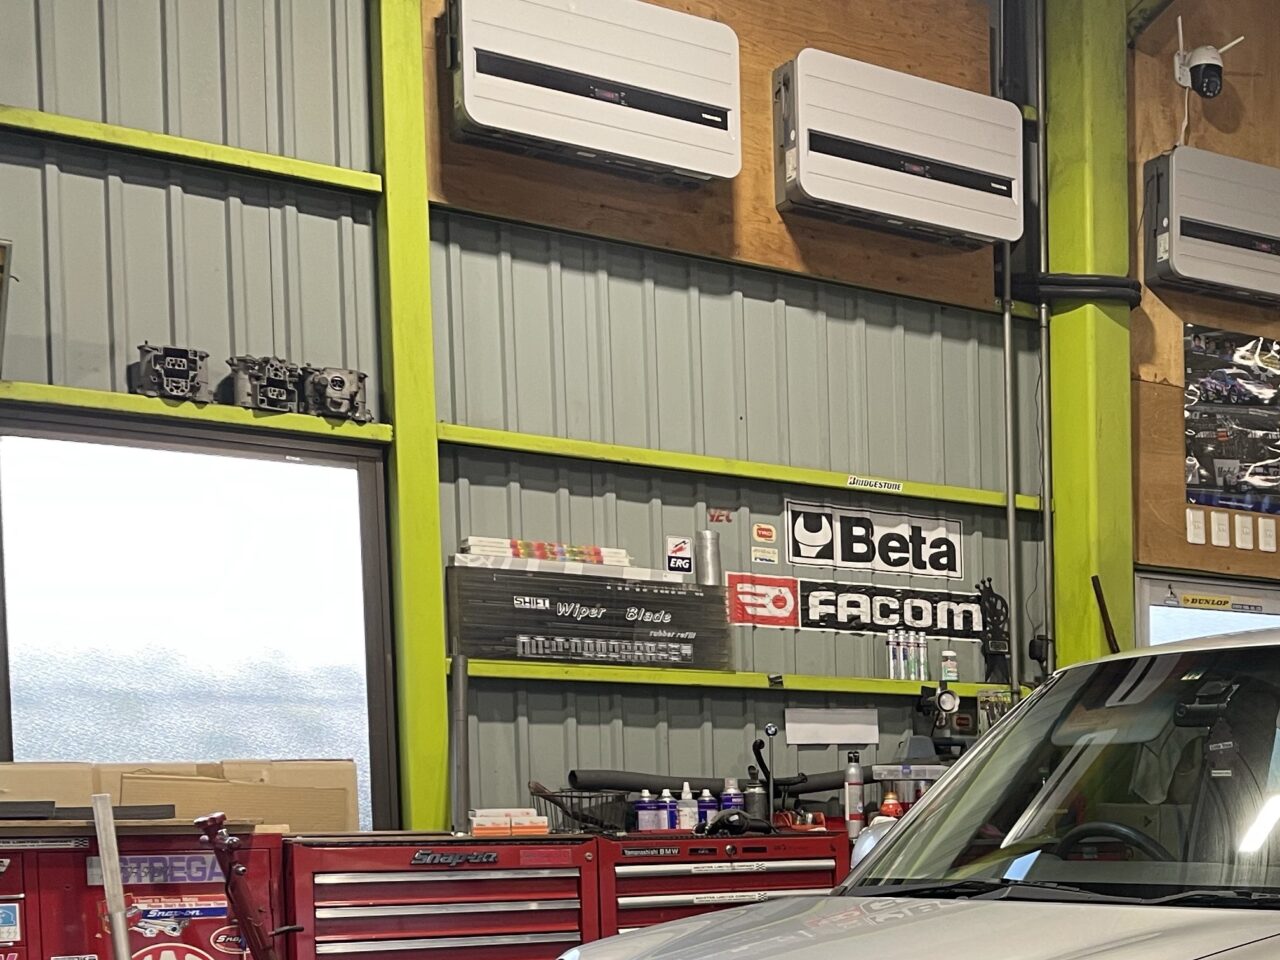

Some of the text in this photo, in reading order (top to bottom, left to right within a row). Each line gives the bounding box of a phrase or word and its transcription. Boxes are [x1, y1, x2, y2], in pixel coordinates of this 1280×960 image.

[849, 476, 901, 490] BRIDGESTONE
[840, 516, 957, 572] Beta
[669, 558, 690, 569] ERG
[514, 596, 550, 609] SHIFT
[1190, 598, 1229, 606] DUNLOP
[556, 602, 672, 623] Wiper Blade
[410, 849, 498, 866] Snap-on
[147, 909, 200, 917] Snap-on
